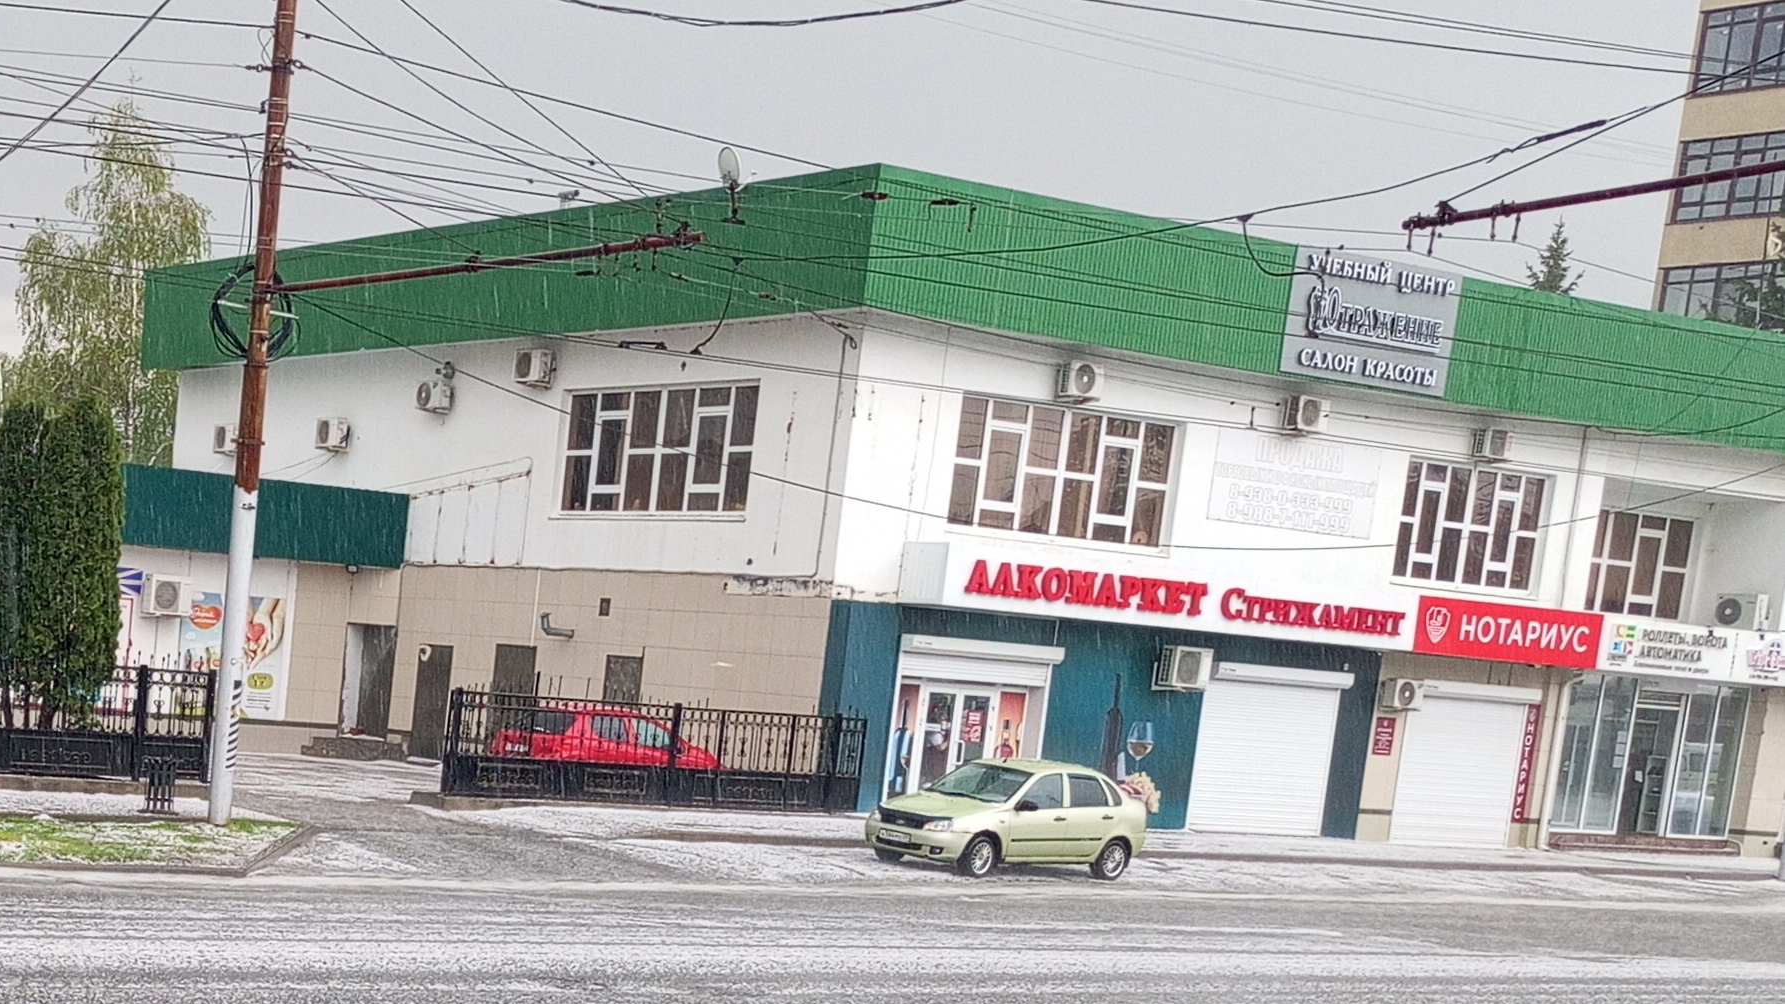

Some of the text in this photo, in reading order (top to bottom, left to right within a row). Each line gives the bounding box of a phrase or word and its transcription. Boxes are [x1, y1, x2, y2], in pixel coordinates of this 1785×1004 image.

[1310, 254, 1456, 297] УЧЕБНЫЙ ЦЕНТР
[1300, 349, 1438, 387] САЛОН КРАСОТЫ
[1254, 435, 1344, 473] ПРОДАЖА
[1226, 501, 1351, 533] 8-988-7-111-999
[1228, 483, 1353, 515] 8-938-0-333-999
[965, 559, 1208, 616] АЛКОМАРКЕТ
[1460, 614, 1590, 653] НОТАРИУС
[1638, 645, 1703, 663] АВТОМАТИКА
[1514, 723, 1536, 819] НОТАРИУС
